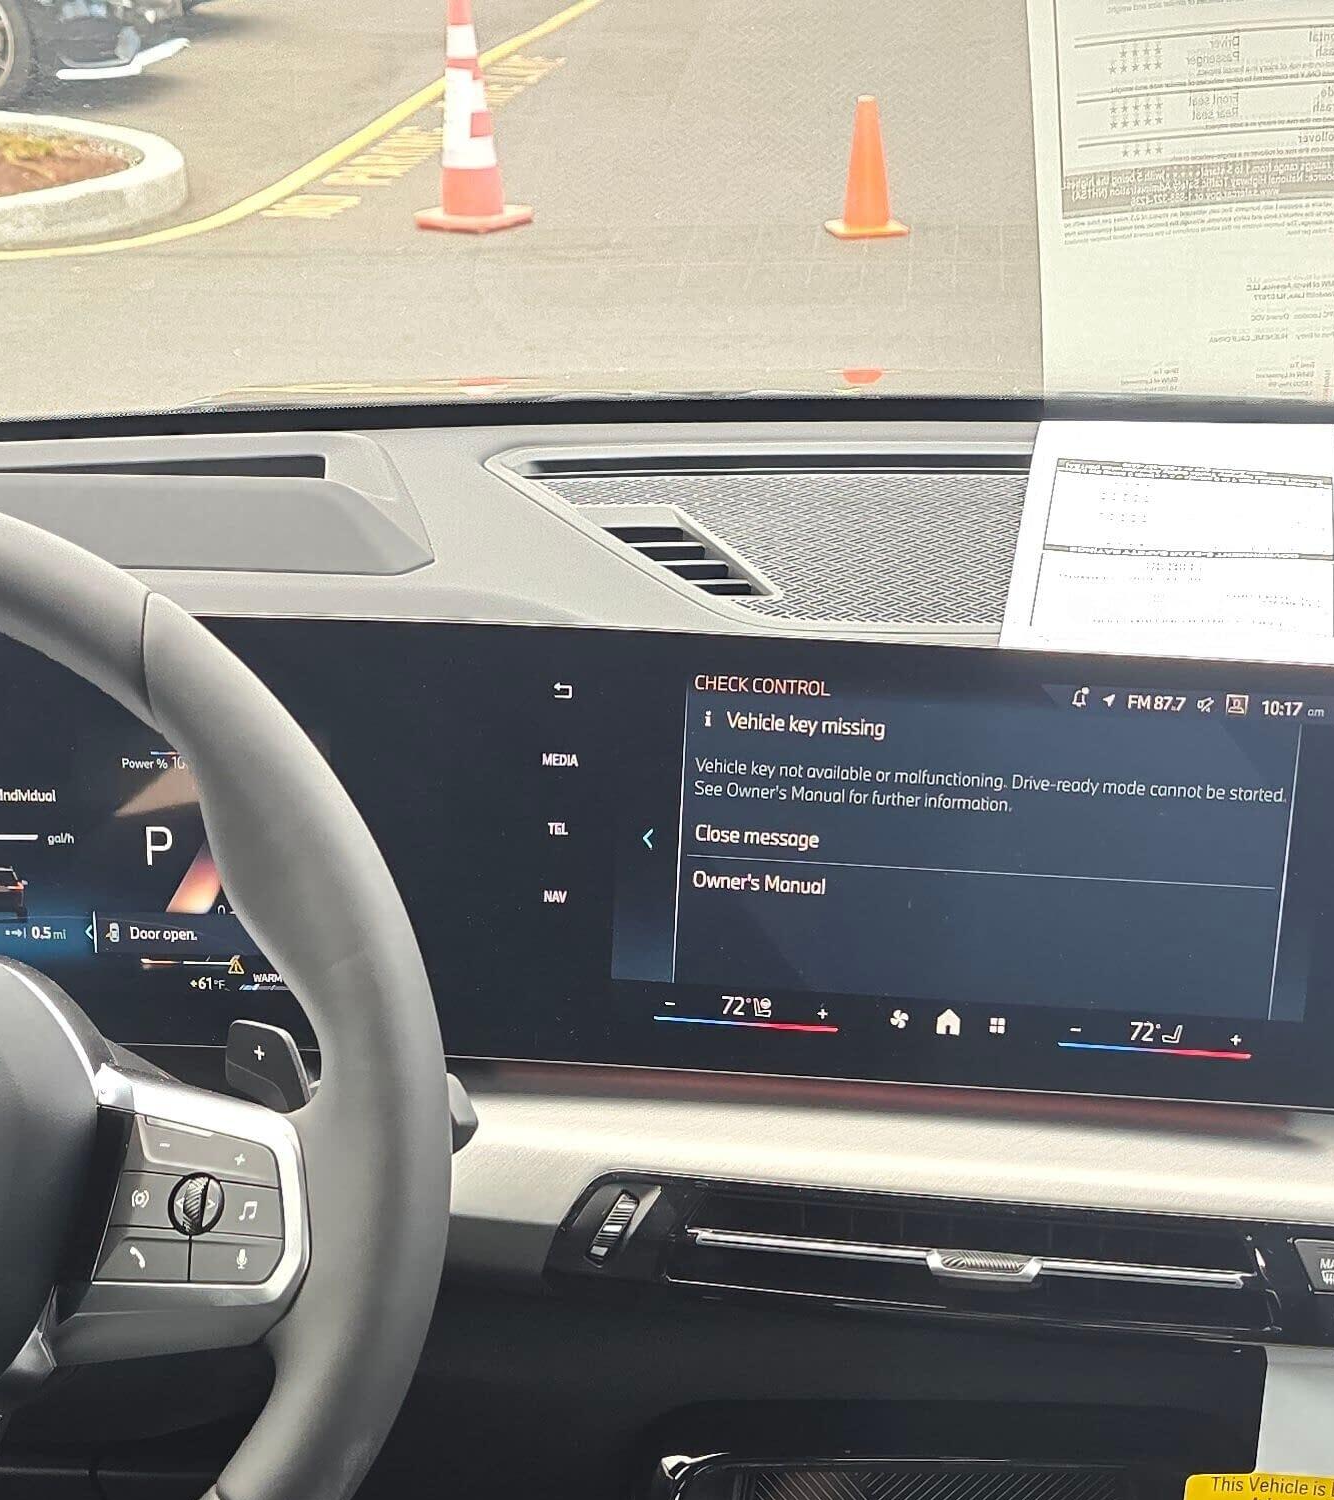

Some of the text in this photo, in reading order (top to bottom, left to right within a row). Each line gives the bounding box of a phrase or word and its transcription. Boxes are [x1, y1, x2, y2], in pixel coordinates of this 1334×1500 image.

[695, 674, 830, 696] CHECK CONTROL
[1128, 695, 1186, 712] FM 87.7
[1261, 700, 1302, 716] 10:17
[726, 711, 886, 741] Vehicle key missing
[121, 756, 187, 769] Power % 10
[542, 753, 579, 767] MEDIA
[695, 757, 1287, 803] Vehicle key not available or malfunctioning. Drive-ready mode cannot be started.
[694, 781, 1013, 813] See Owner's Manual for further information.
[47, 833, 74, 845] gal/h
[145, 826, 172, 865] P
[695, 824, 819, 851] Close message
[693, 870, 826, 895] Owner's Manual
[543, 890, 567, 904] NAV
[31, 927, 66, 939] 0.5 mi
[129, 927, 197, 942] Door open.
[1211, 1477, 1243, 1492] This
[1250, 1477, 1308, 1495] Vehicle
[1313, 1481, 1326, 1496] is
